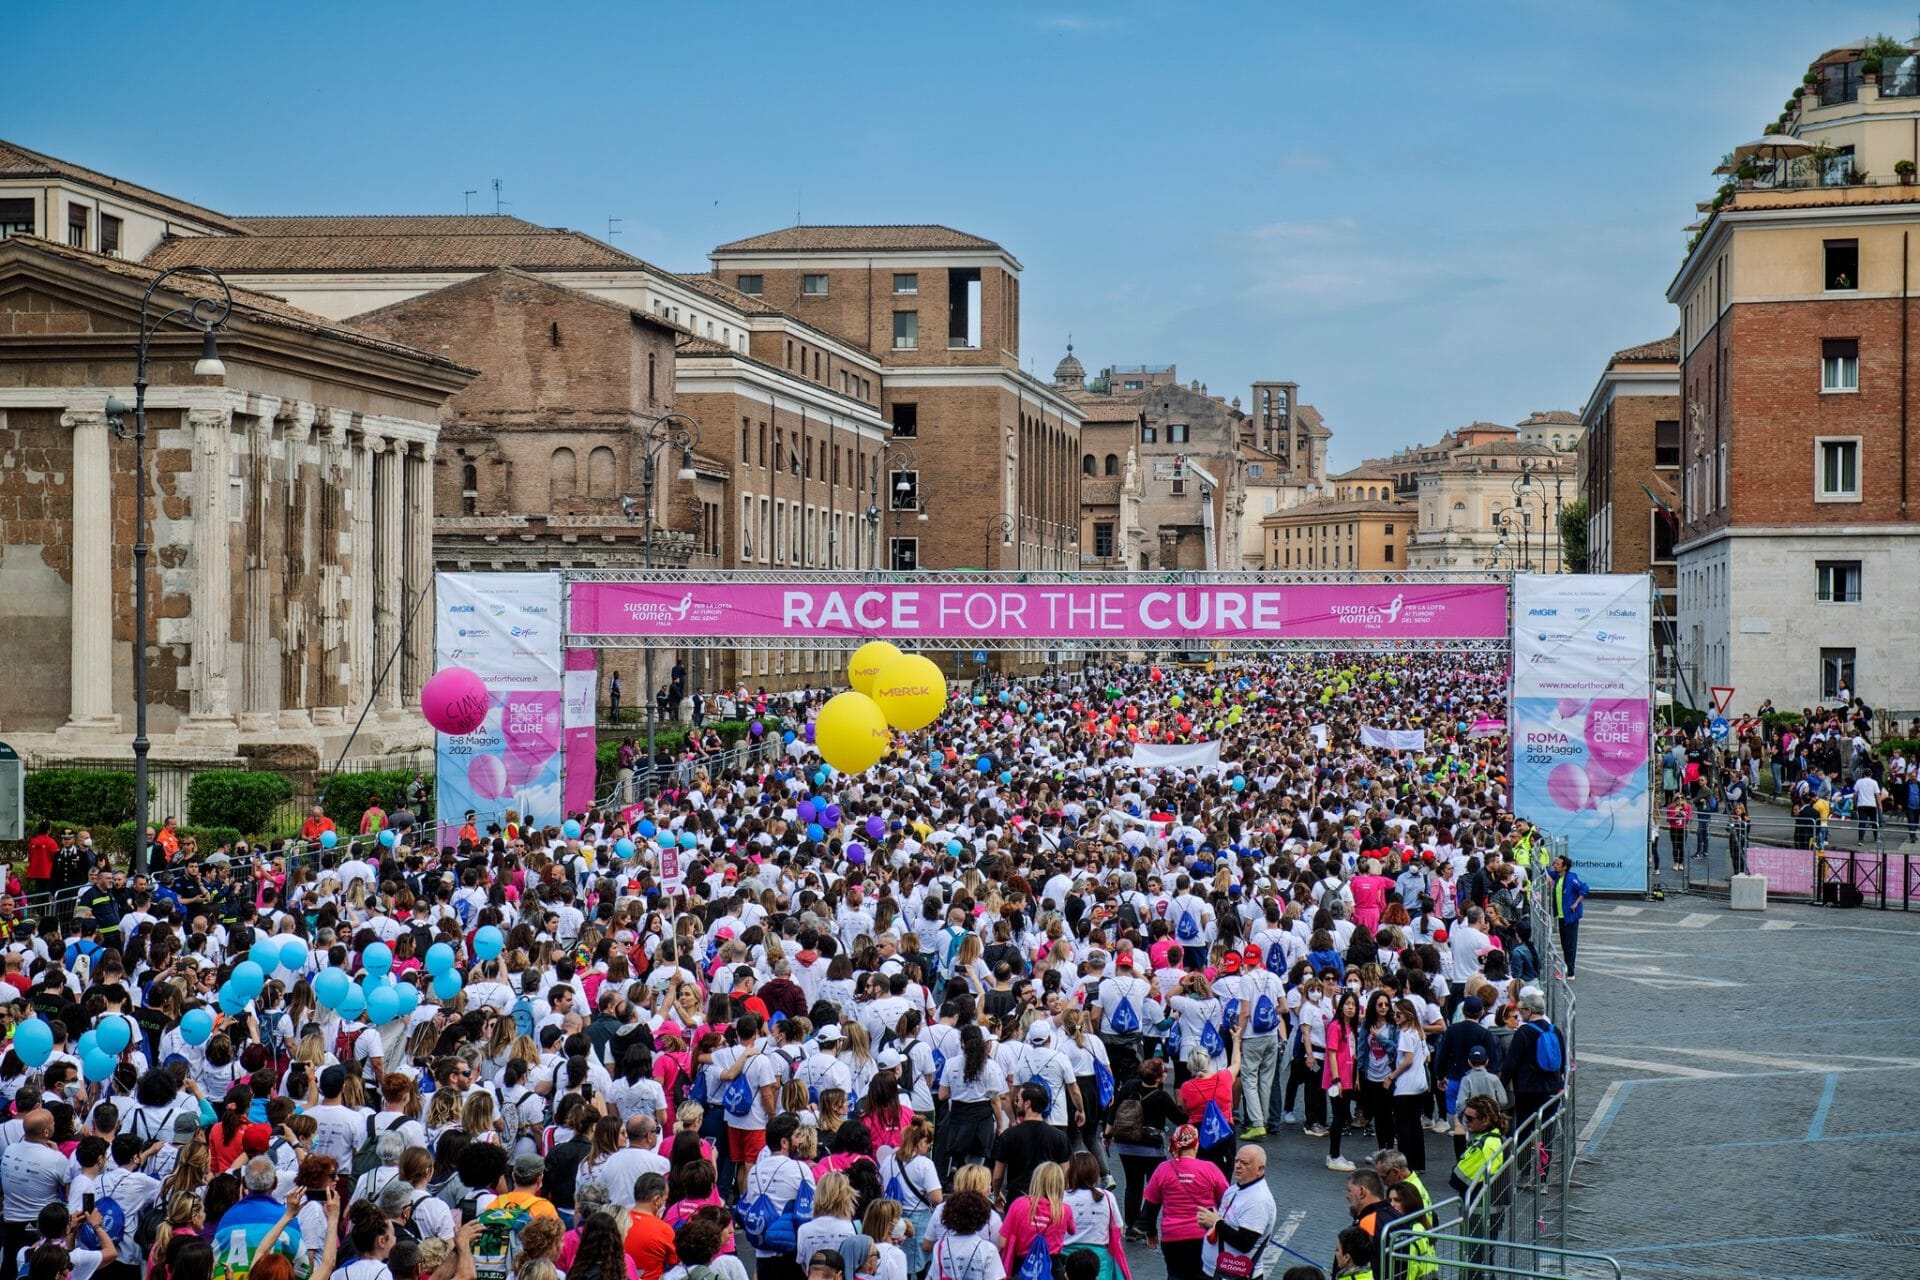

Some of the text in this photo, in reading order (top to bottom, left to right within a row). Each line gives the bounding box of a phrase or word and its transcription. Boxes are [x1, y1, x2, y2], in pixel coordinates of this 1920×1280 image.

[783, 592, 1281, 630] RACE FOR THE CURE
[1528, 608, 1557, 616] AMGEN
[1606, 609, 1637, 617] UniSalute
[855, 668, 880, 676] MER
[481, 675, 538, 683] aceforthecure.it
[1539, 682, 1624, 690] www.raceforthecure.it
[880, 687, 929, 697] MERCK
[510, 703, 543, 713] RACE
[510, 713, 558, 723] FOR THE
[1594, 711, 1629, 721] RACE
[510, 724, 543, 734] CURE
[1594, 722, 1644, 733] FOR THE
[449, 737, 500, 748] 5-8 Maggio
[1527, 733, 1568, 743] ROMA
[1594, 732, 1630, 743] CURE
[449, 747, 472, 755] 2022
[1527, 745, 1582, 756] 5-8 Maggio
[1527, 755, 1552, 764] 2022
